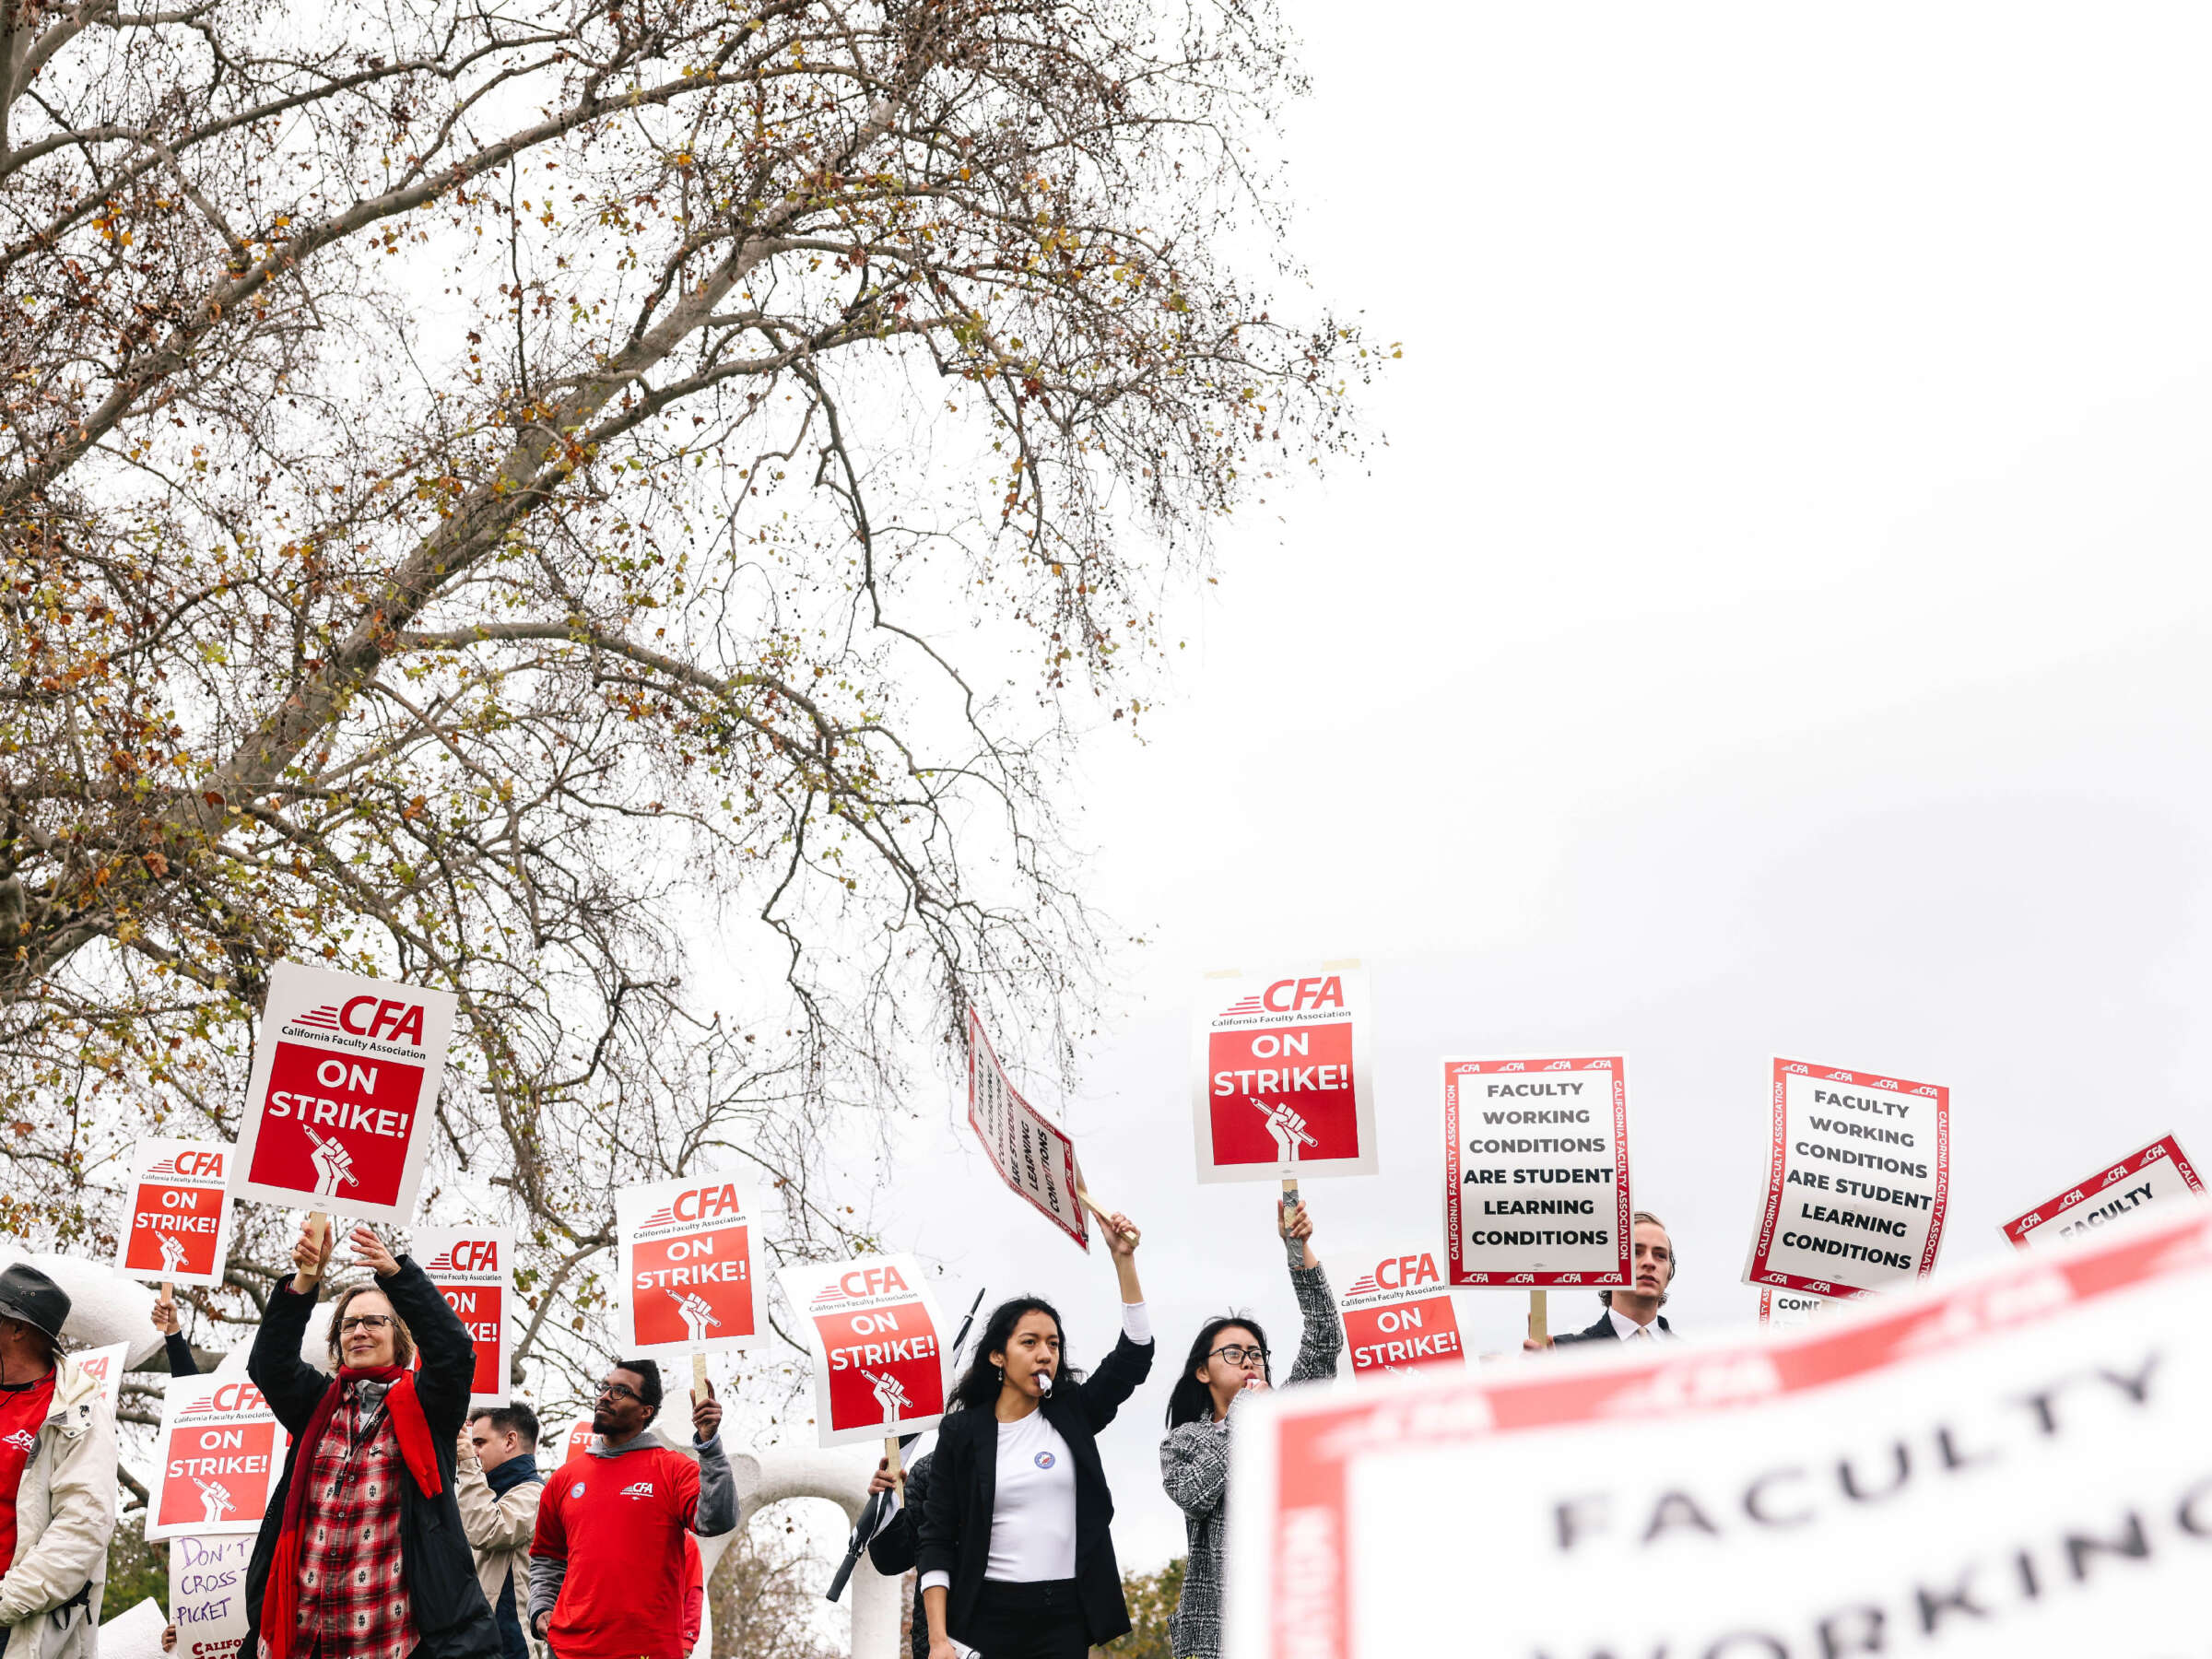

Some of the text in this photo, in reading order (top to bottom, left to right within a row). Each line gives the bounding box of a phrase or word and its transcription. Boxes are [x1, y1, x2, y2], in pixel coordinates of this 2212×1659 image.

[1263, 975, 1344, 1013] CFA
[339, 995, 424, 1046] CFA
[1211, 1010, 1351, 1027] California Faculty Association
[281, 1025, 426, 1060] California Faculty Association
[1251, 1031, 1309, 1058] ON
[316, 1060, 379, 1095] ON
[1214, 1064, 1348, 1097] STRIKE!
[1461, 1060, 1612, 1073] CFA CFA CFA CFA
[1790, 1064, 1938, 1098] CFA CFA CFA CFA
[1487, 1082, 1584, 1098] FACULTY
[1814, 1089, 1910, 1119] FACULTY
[268, 1090, 409, 1139] STRIKE!
[1482, 1110, 1590, 1124] WORKING
[1809, 1115, 1914, 1147] WORKING
[1021, 1120, 1039, 1192] LEARNING
[1469, 1138, 1606, 1154] CONDITIONS
[1795, 1141, 1928, 1179] CONDITIONS
[141, 1173, 170, 1182] California
[174, 1150, 223, 1178] CFA
[1010, 1157, 1021, 1188] ARE
[1037, 1127, 1060, 1213] CONDITIONS
[1447, 1085, 1459, 1261] CALIFORNIA FACULTY ASSOCIATION
[1463, 1168, 1614, 1184] ARE STUDENT
[1614, 1080, 1629, 1260] CALIFORNIA FACULTY ASSOCIATION
[1758, 1082, 1783, 1257] CALIFORNIA FACULTY ASSOCIATION
[161, 1190, 198, 1209] ON
[1786, 1170, 1933, 1211] ARE STUDENT
[1919, 1111, 1947, 1282] CALIFORNIA FACULTY ASSOCIATIO
[2021, 1144, 2167, 1230] CFA CFA CFA CFA
[673, 1183, 739, 1222] CFA
[1484, 1200, 1594, 1216] LEARNING
[2059, 1182, 2154, 1239] FACULTY
[135, 1212, 218, 1234] STRIKE!
[633, 1215, 747, 1240] California Faculty Association
[1801, 1203, 1908, 1238] LEARNING
[666, 1237, 713, 1261] ON
[1471, 1230, 1608, 1246] CONDITIONS
[1782, 1231, 1912, 1270] CONDITIONS
[451, 1241, 498, 1272] CFA
[448, 1273, 468, 1281] Faculty
[636, 1260, 747, 1289] STRIKE!
[840, 1265, 909, 1298] CFA
[1375, 1253, 1440, 1290] CFA
[1469, 1274, 1623, 1283] CFA CFA CFA CFA
[1769, 1273, 1831, 1293] CFA CFA
[443, 1291, 477, 1313] ON
[809, 1292, 918, 1312] California Faculty Association
[1341, 1296, 1377, 1307] California
[1378, 1291, 1405, 1300] Faculty
[851, 1312, 900, 1335] ON
[1377, 1307, 1423, 1334] ON
[830, 1335, 935, 1371] STRIKE!
[1354, 1331, 1458, 1368] STRIKE!
[78, 1356, 109, 1381] FA
[173, 1415, 207, 1424] California
[208, 1413, 235, 1421] Faculty
[199, 1430, 243, 1451] ON
[1552, 1347, 2164, 1552] FACULTY
[168, 1454, 268, 1478] STRIKE!
[632, 1482, 653, 1494] CFA
[181, 1571, 237, 1595] CROSS
[177, 1596, 231, 1627] PICKET
[192, 1638, 245, 1655] CALIFO
